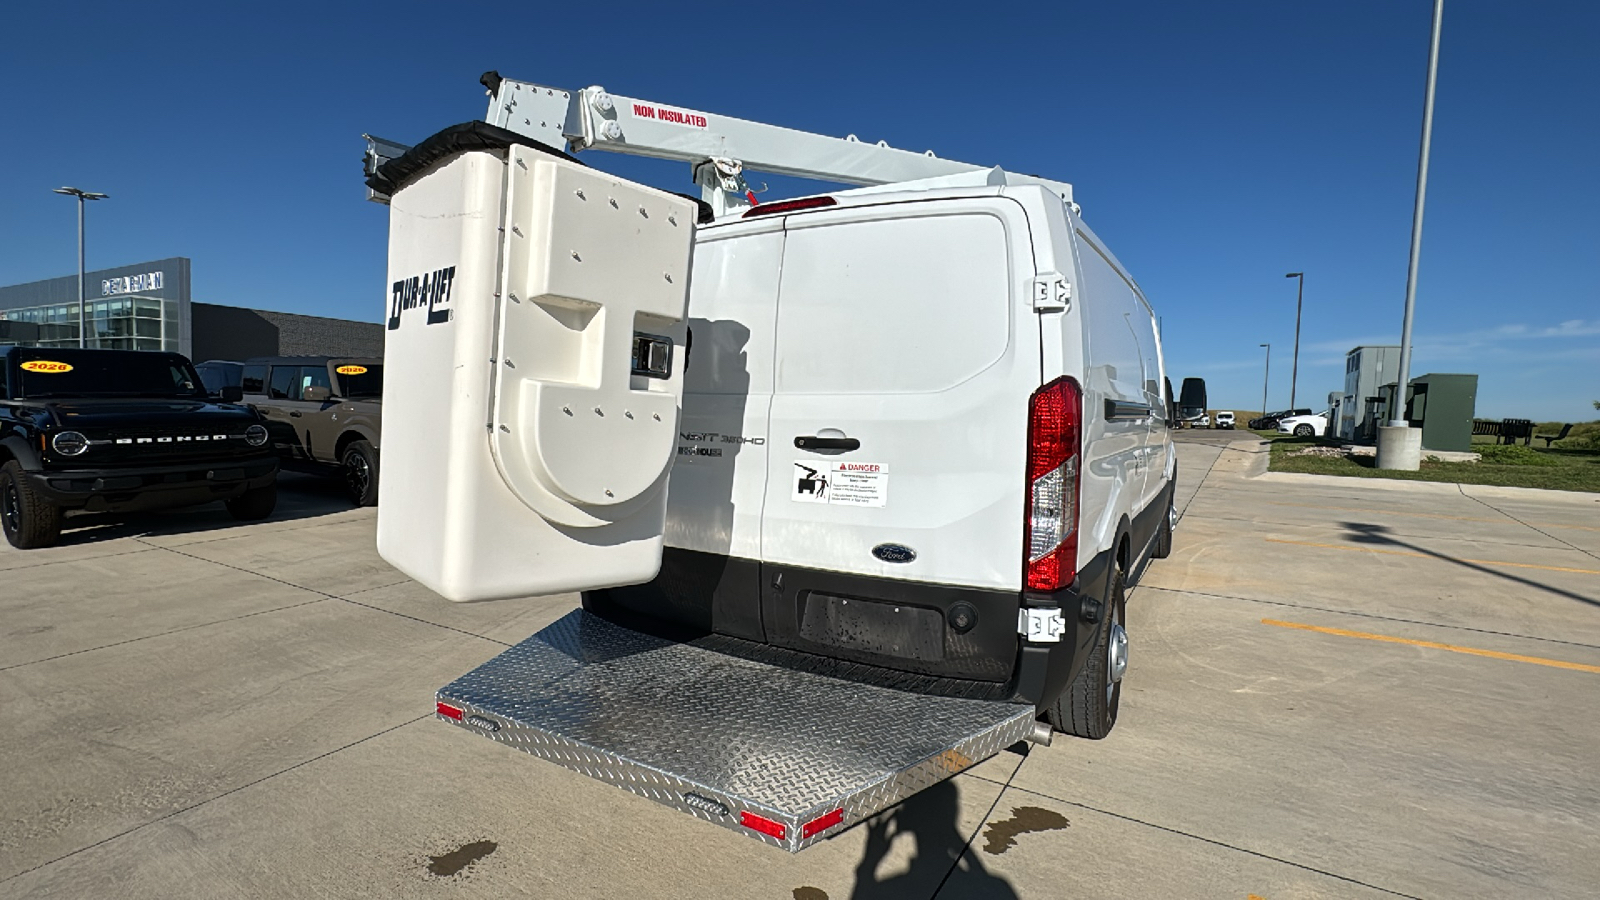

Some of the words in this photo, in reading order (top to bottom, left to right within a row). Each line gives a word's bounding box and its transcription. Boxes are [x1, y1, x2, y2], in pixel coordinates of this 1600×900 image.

[633, 104, 655, 119] NON
[658, 108, 707, 127] INSULATED
[28, 363, 67, 371] 2026
[116, 434, 227, 444] BRONCO
[680, 431, 719, 442] NSIT
[848, 463, 880, 472] DANGER
